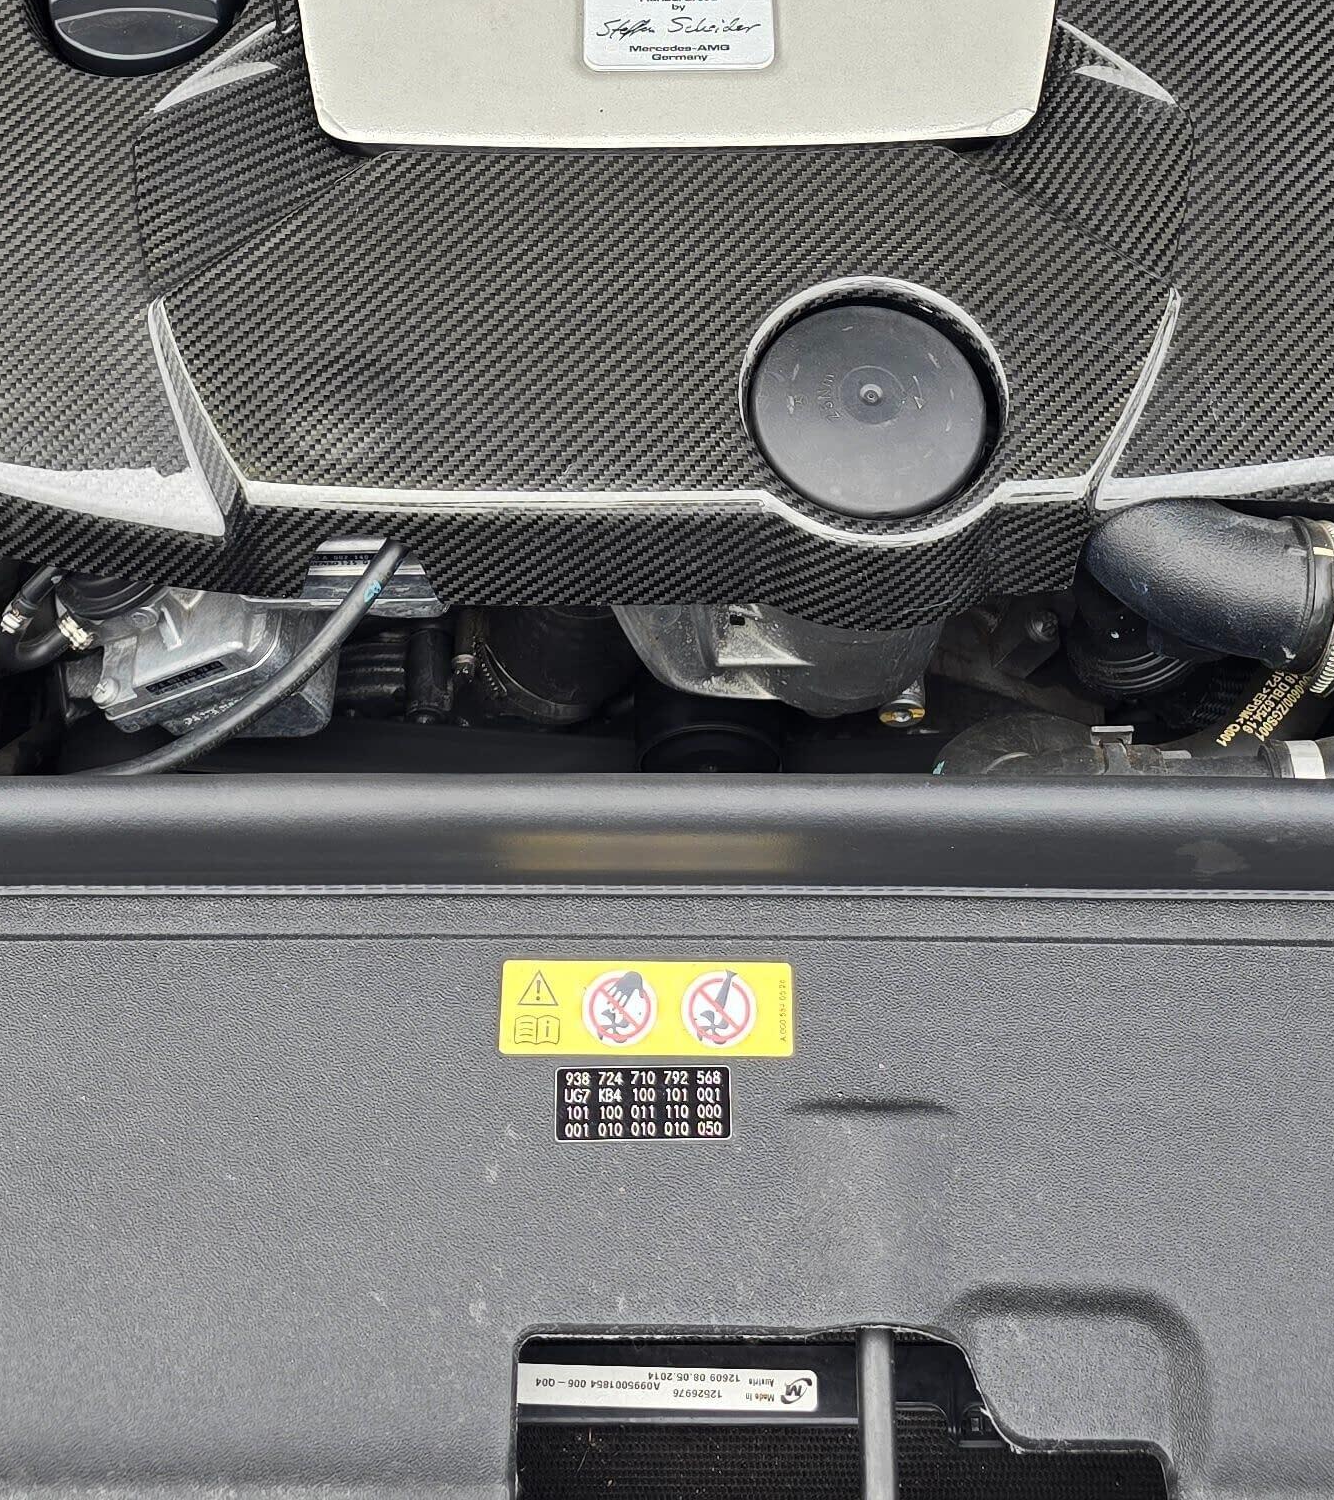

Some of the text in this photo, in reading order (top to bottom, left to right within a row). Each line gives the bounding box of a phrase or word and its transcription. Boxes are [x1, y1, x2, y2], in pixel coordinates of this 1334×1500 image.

[671, 3, 686, 11] by
[651, 53, 708, 62] Germany
[565, 1071, 721, 1085] 938 724 710 792 568
[565, 1088, 721, 1102] UG7 KB4 100 101 001
[565, 1106, 590, 1120] 101
[598, 1106, 622, 1120] 100
[631, 1106, 655, 1120] 011
[664, 1106, 688, 1120] 110
[565, 1123, 590, 1137] 001
[598, 1123, 622, 1137] 010
[631, 1123, 655, 1137] 010
[664, 1123, 688, 1137] 010
[648, 1371, 741, 1382] 12609 08.05.2014
[591, 1380, 660, 1391] A0995001854
[672, 1389, 723, 1399] 12526976
[755, 1392, 775, 1402] Made
